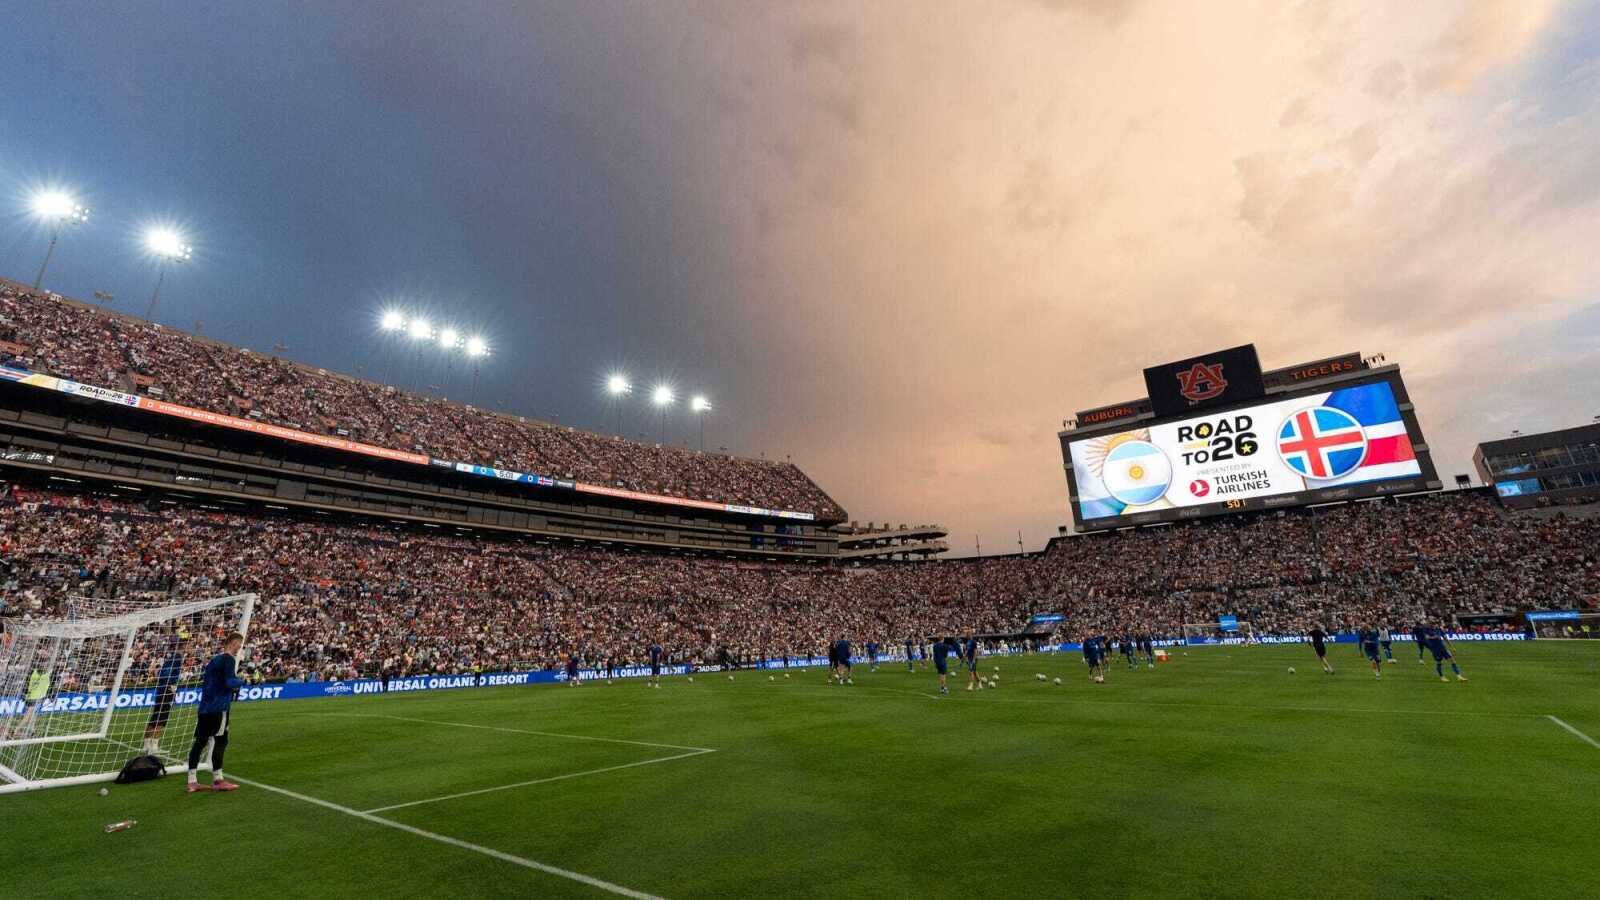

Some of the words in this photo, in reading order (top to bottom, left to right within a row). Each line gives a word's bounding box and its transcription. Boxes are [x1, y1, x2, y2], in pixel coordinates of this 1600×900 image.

[1292, 361, 1353, 380] TIGERS
[80, 385, 106, 395] ROAD
[1084, 408, 1136, 424] AUBURN
[1177, 415, 1253, 443] ROAD
[1182, 450, 1209, 466] TO
[1197, 464, 1240, 475] PRESENTED
[1213, 470, 1268, 485] TURKISH
[1216, 479, 1271, 495] AIRLINES
[488, 674, 529, 685] RESORT
[579, 670, 619, 680] NIVRSL
[620, 667, 653, 677] ORLAND
[659, 666, 686, 675] REORT
[0, 694, 109, 715] NIERSAL
[233, 686, 283, 701] SORT
